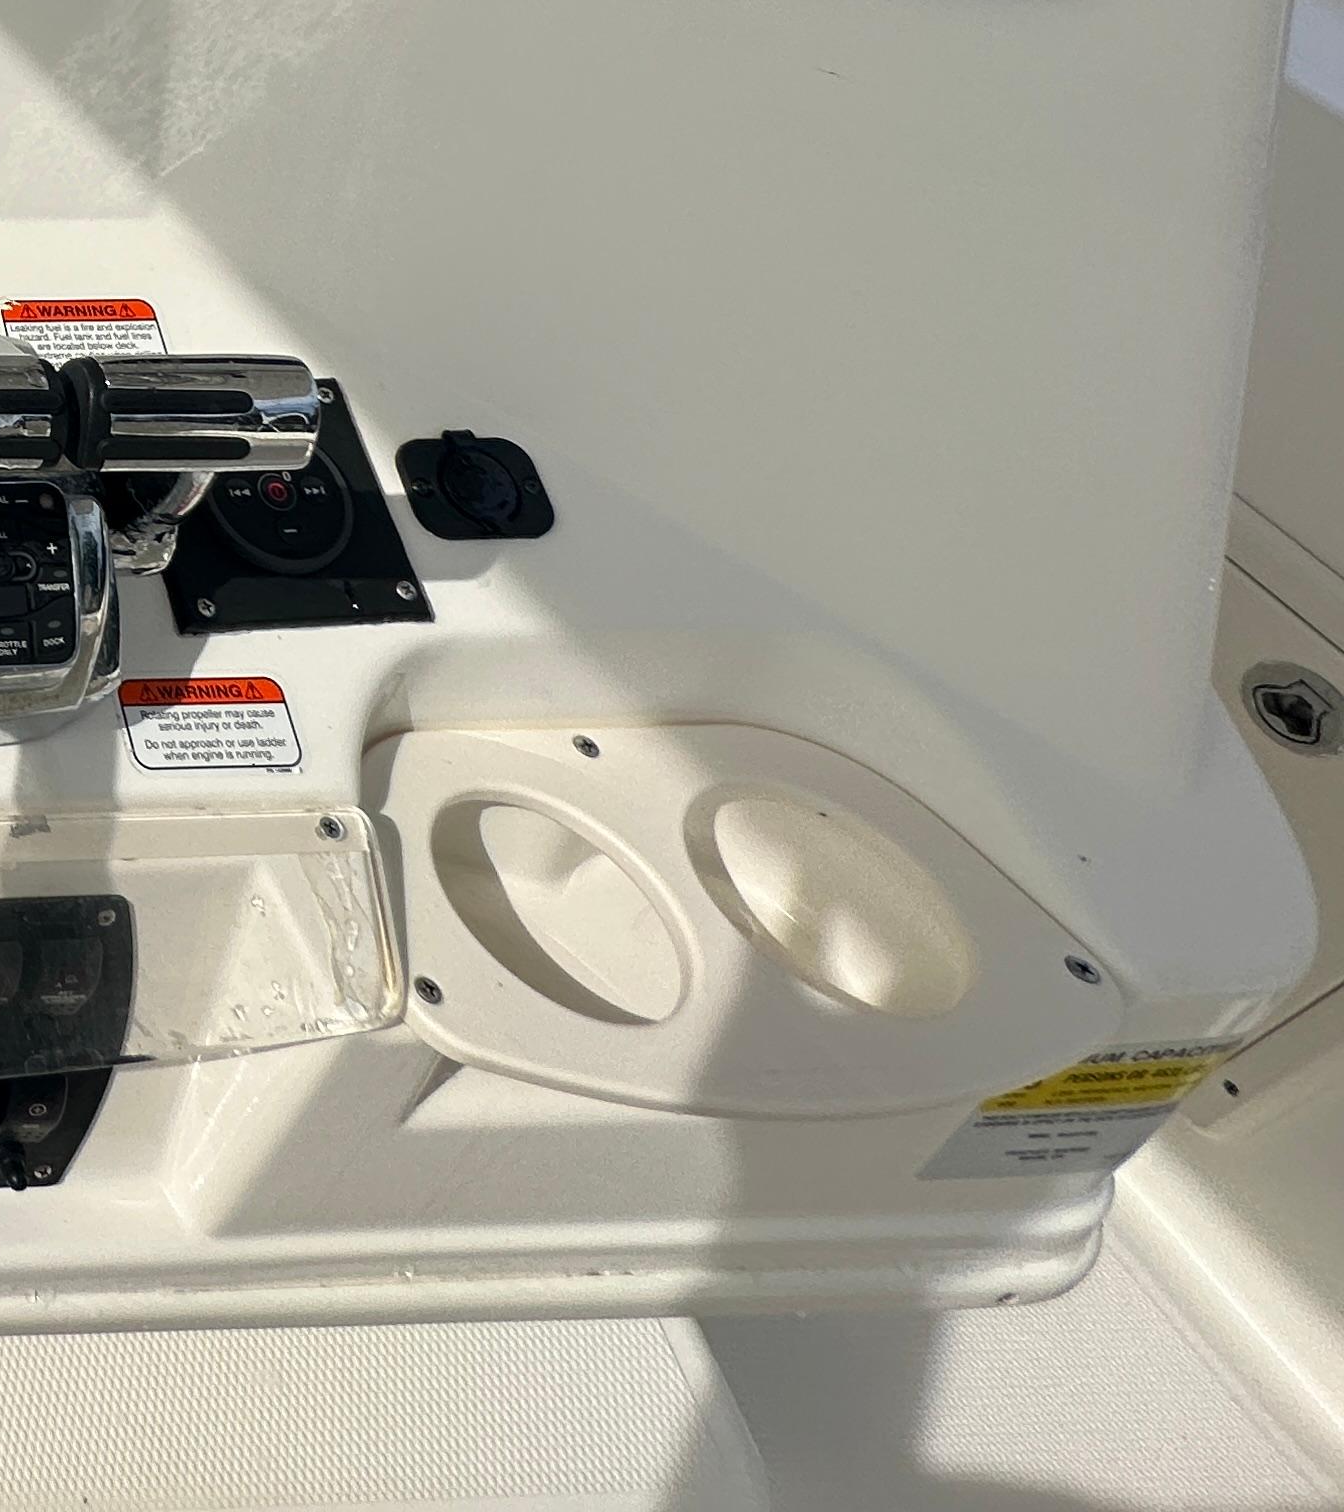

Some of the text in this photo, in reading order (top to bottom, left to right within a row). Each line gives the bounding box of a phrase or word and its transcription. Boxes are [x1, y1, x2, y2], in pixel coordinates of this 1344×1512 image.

[36, 304, 117, 317] WARNING
[115, 323, 156, 333] explosion
[53, 333, 72, 341] Fuel
[96, 332, 112, 340] and
[53, 342, 85, 350] located
[88, 342, 113, 350] below
[42, 637, 66, 648] DOCK
[156, 684, 242, 699] WARNING
[140, 709, 275, 721] Rotating propeller may cause
[222, 722, 232, 730] or
[144, 739, 159, 750] Do
[161, 739, 177, 749] not
[179, 738, 224, 750] approach
[226, 739, 235, 748] or
[238, 739, 254, 748] use
[163, 751, 190, 761] when
[192, 751, 224, 762] engine
[236, 750, 274, 761] running.
